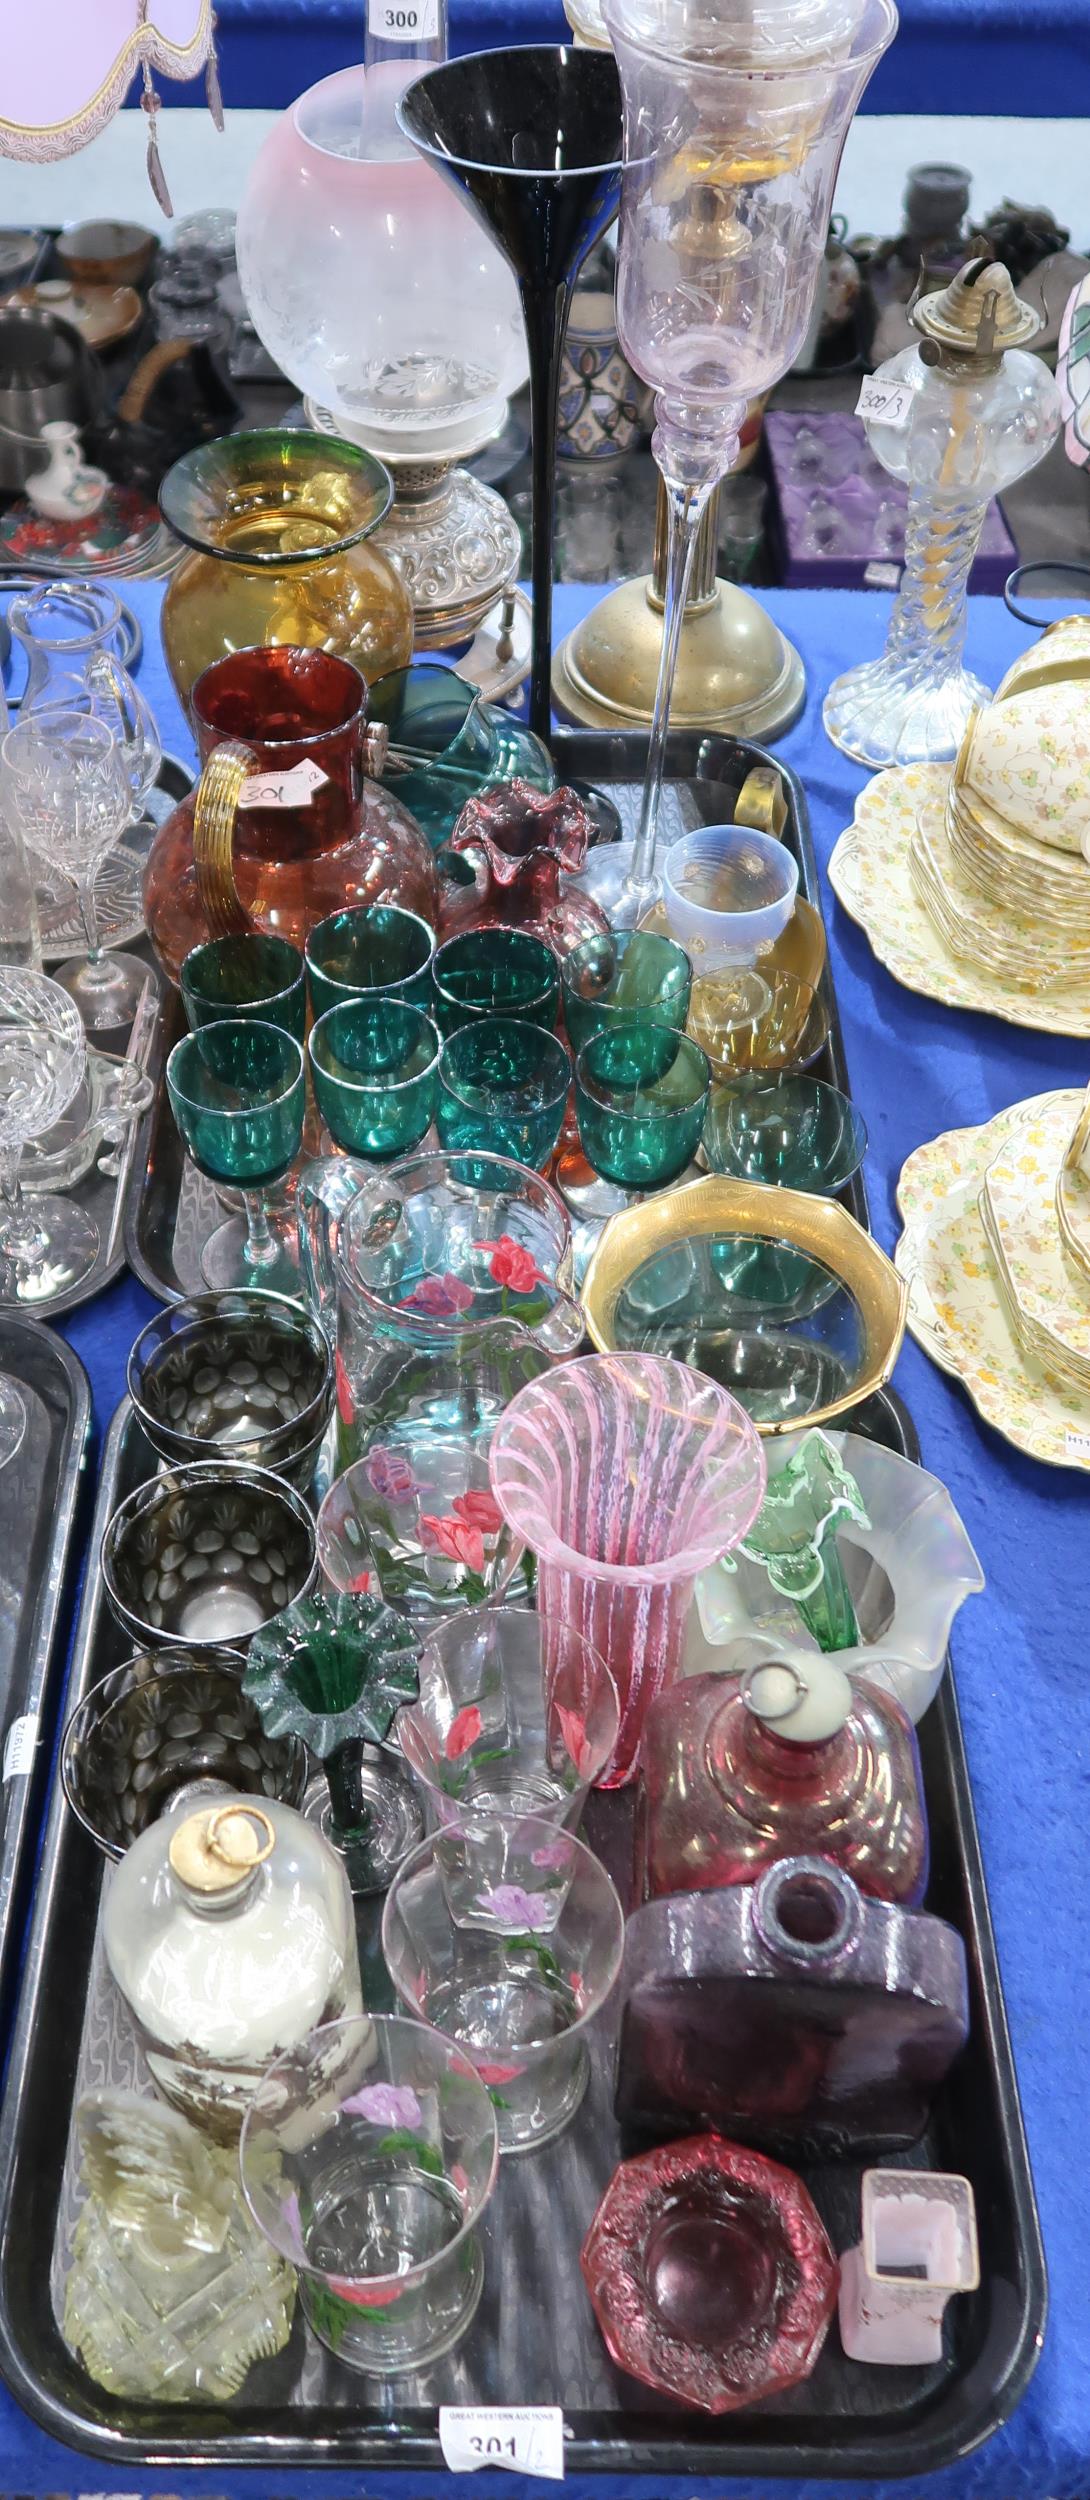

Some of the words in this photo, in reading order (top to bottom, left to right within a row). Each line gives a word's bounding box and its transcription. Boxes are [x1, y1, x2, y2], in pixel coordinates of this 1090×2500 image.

[385, 9, 418, 27] 300
[241, 786, 284, 803] 301
[449, 2412, 474, 2421] GREAT
[477, 2412, 513, 2421] WESTERN
[515, 2412, 554, 2421] AUCTIONS
